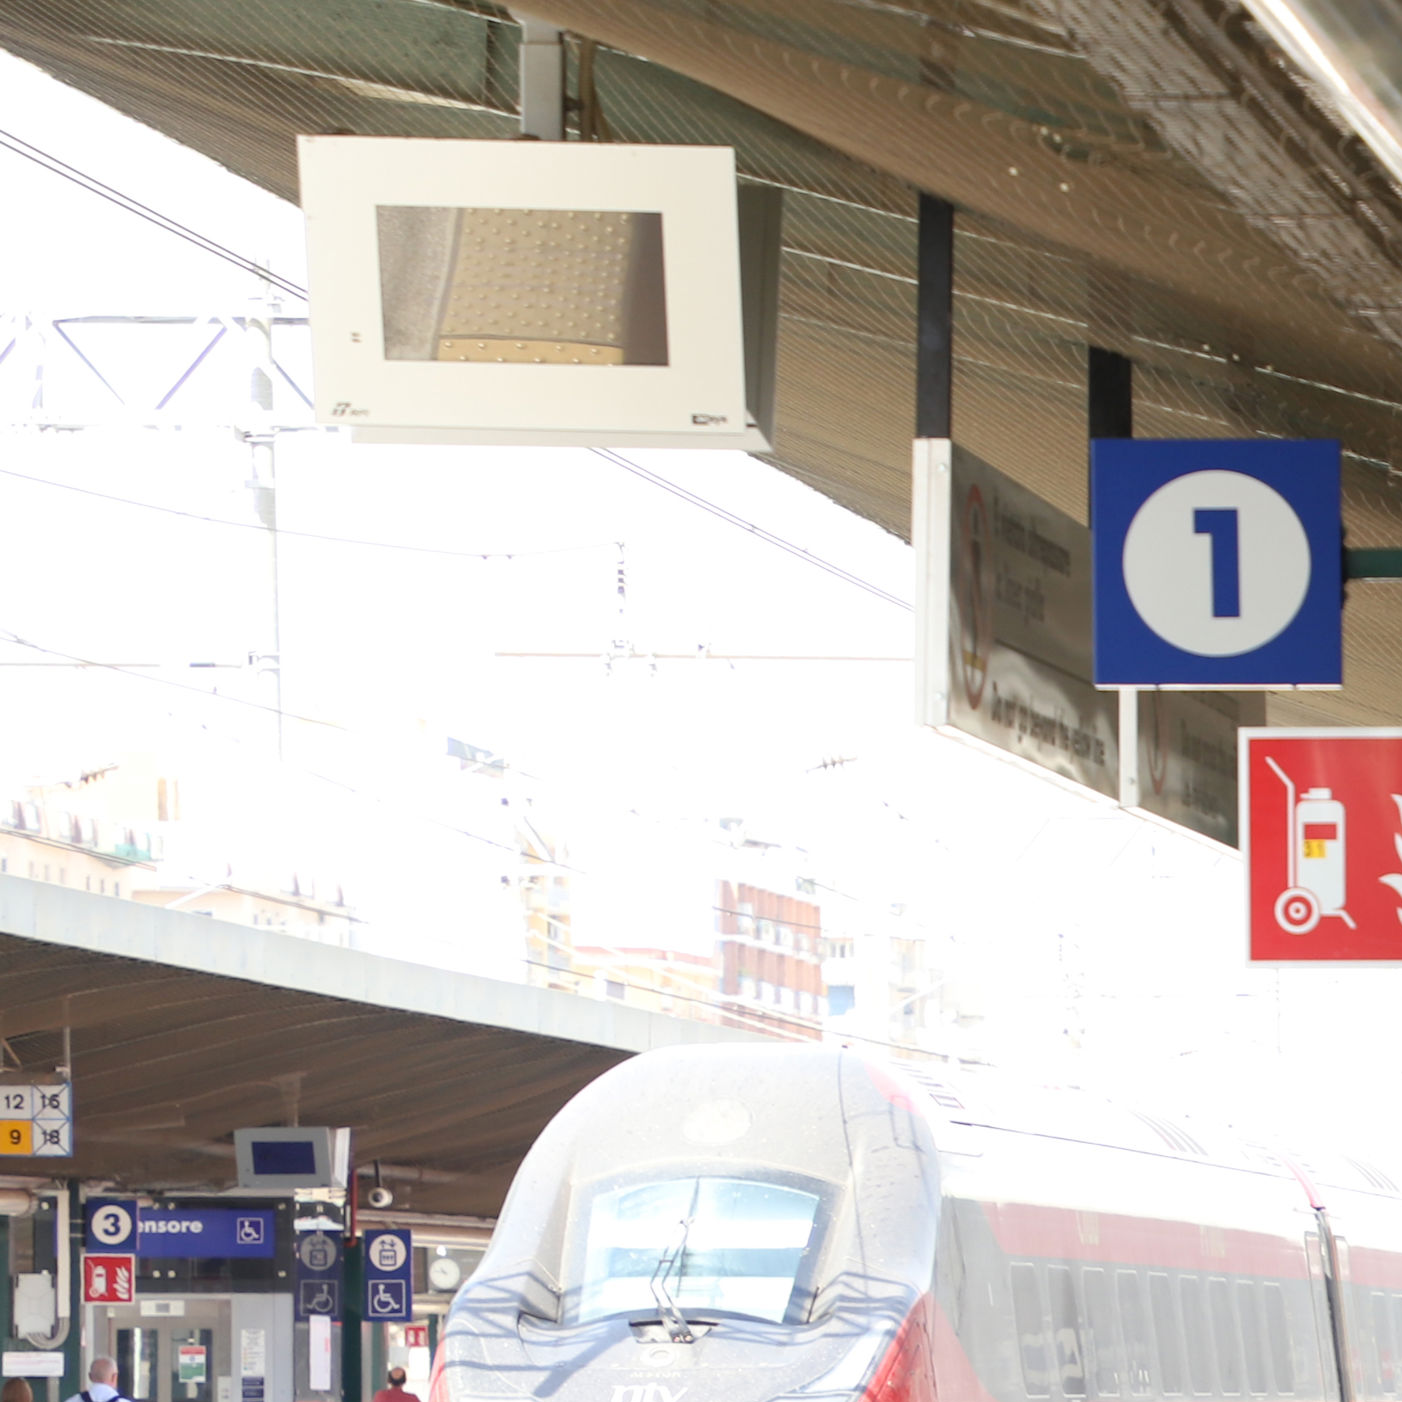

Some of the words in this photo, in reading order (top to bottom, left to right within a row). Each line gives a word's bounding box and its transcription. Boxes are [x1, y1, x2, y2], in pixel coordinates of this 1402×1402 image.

[1193, 508, 1240, 617] 1
[4, 1094, 24, 1109] 12
[40, 1094, 60, 1109] 16
[10, 1130, 21, 1145] 9
[102, 1213, 121, 1237] 3
